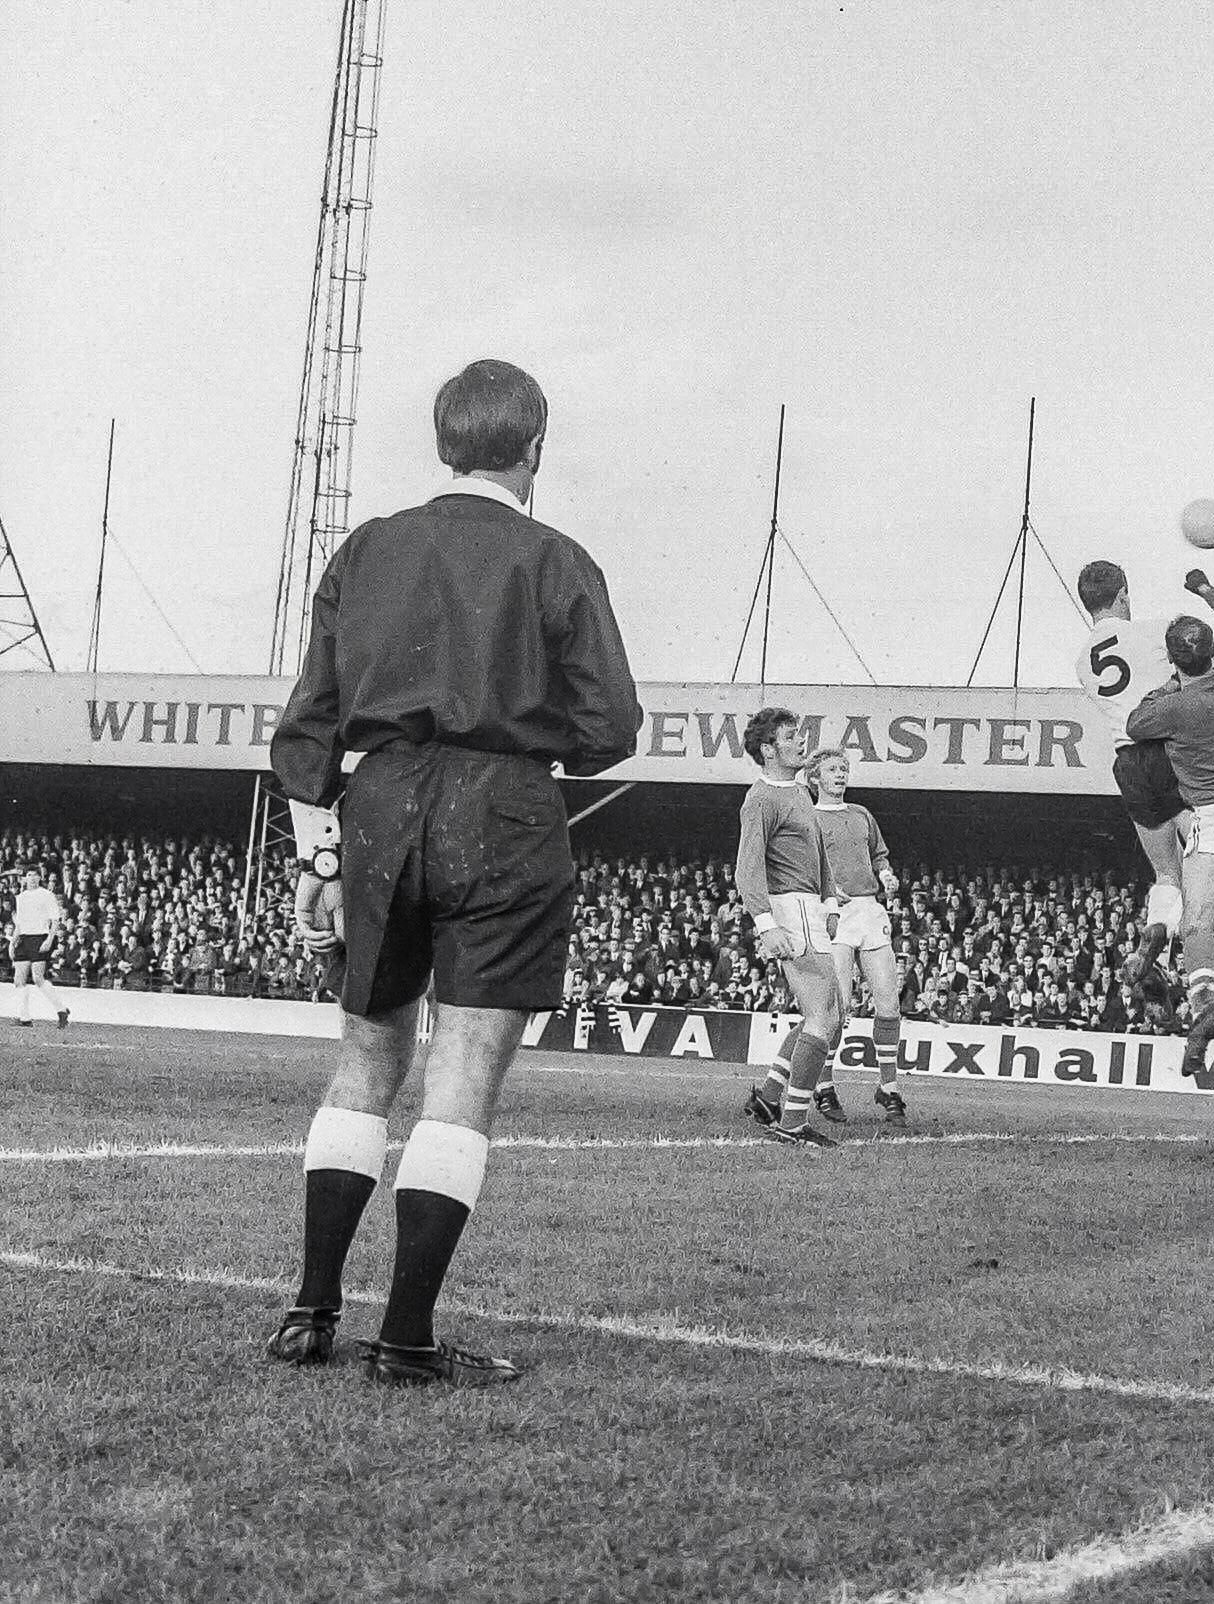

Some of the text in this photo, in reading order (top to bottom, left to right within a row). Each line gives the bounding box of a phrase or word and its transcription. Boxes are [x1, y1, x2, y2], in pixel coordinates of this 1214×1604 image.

[1090, 634, 1131, 697] 5
[86, 700, 1087, 768] WHITB EWASTER
[521, 1010, 715, 1059] VIVA
[789, 1022, 1154, 1086] auxhall
